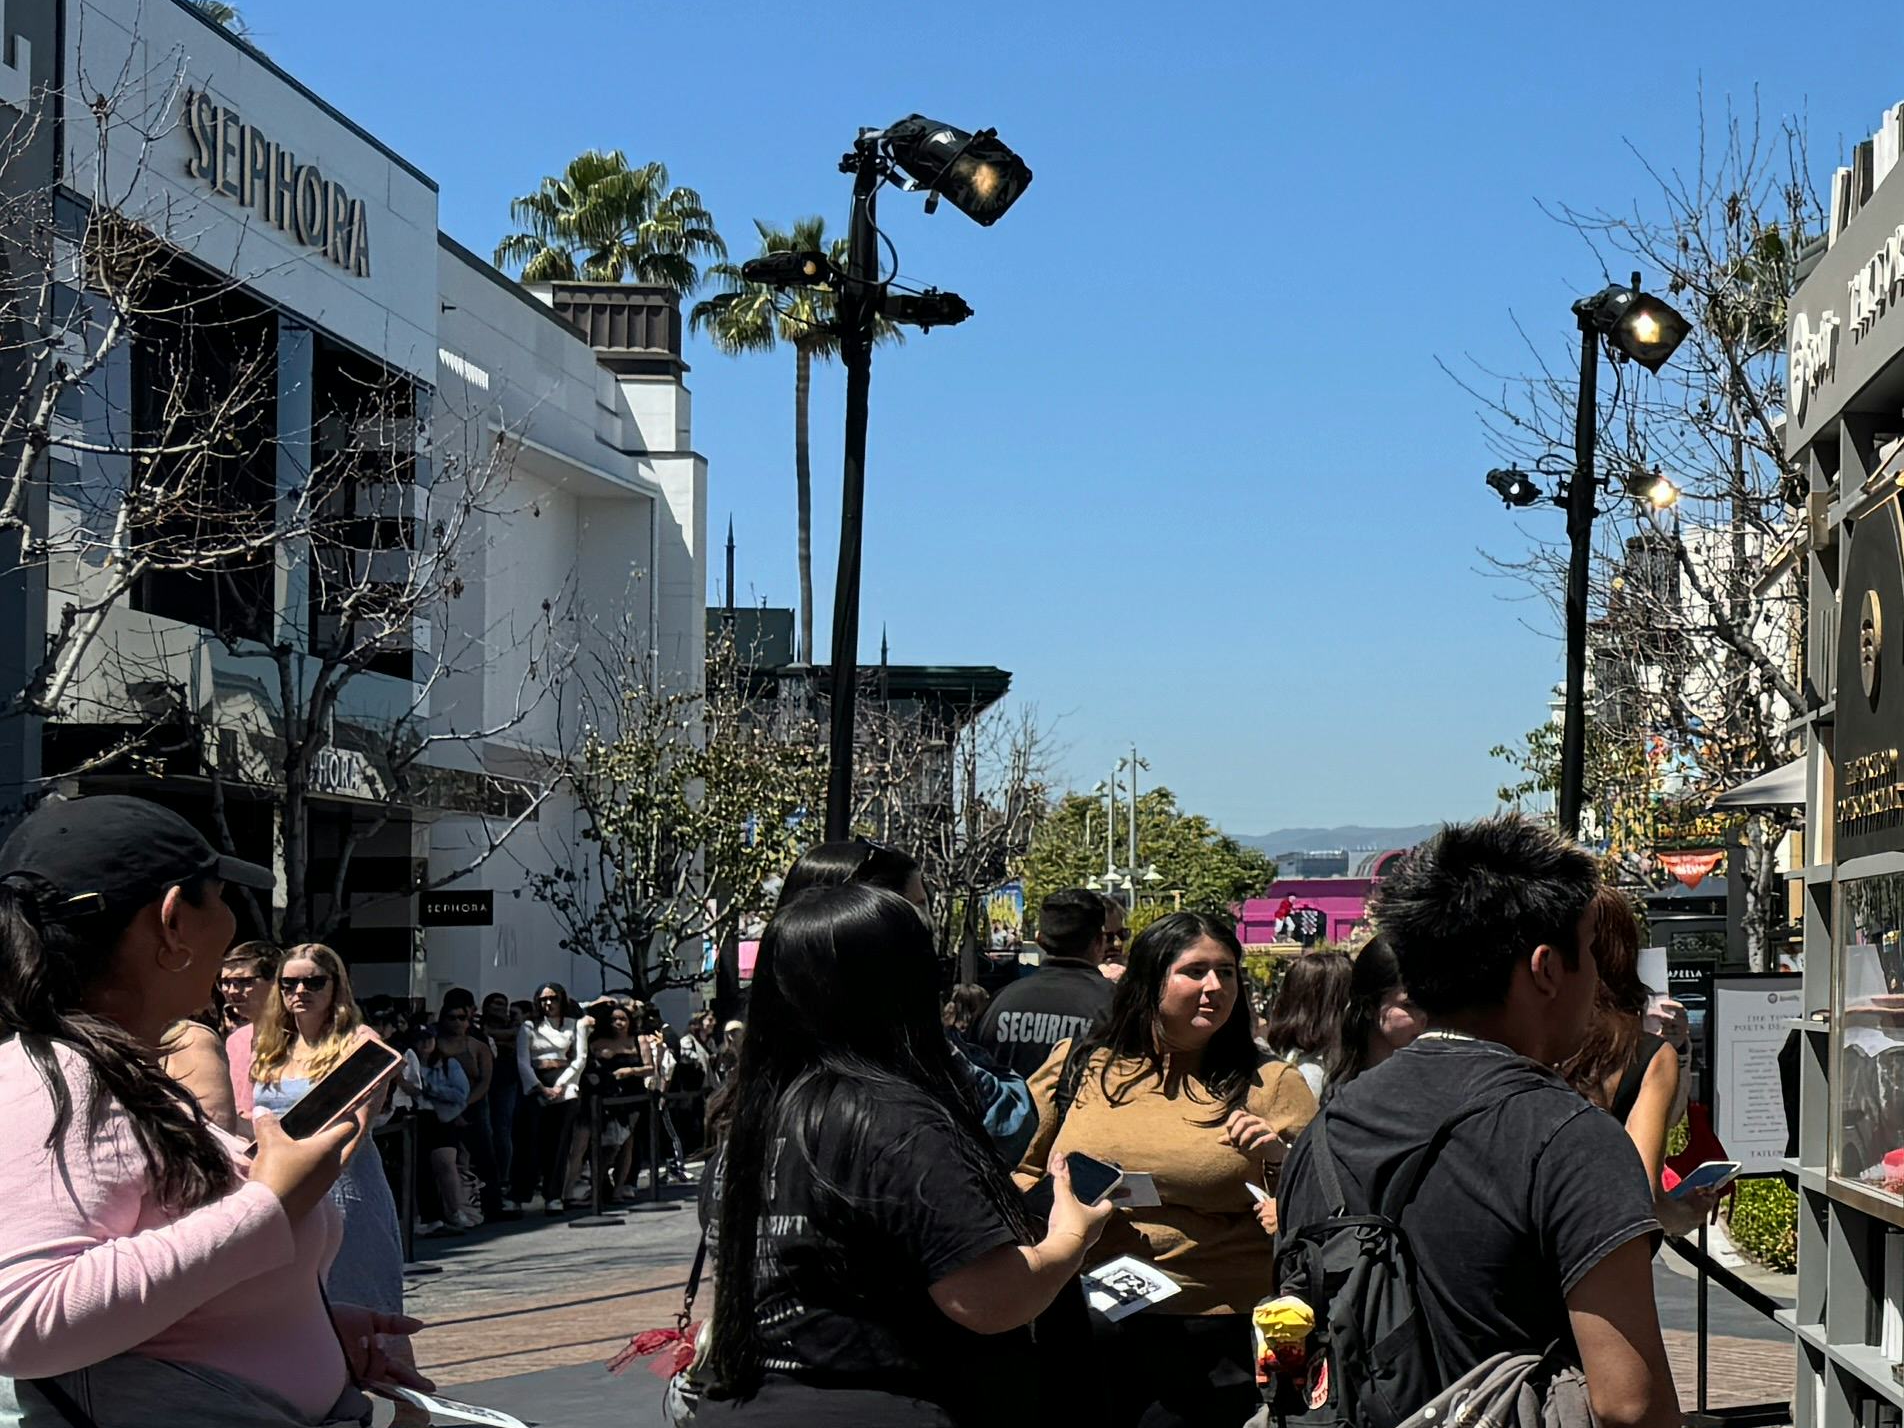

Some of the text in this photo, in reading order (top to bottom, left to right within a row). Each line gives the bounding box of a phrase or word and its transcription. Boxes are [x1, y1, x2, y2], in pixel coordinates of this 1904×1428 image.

[187, 90, 371, 278] SEPHORA
[311, 751, 361, 791] HORA
[996, 1011, 1094, 1044] SECURITY
